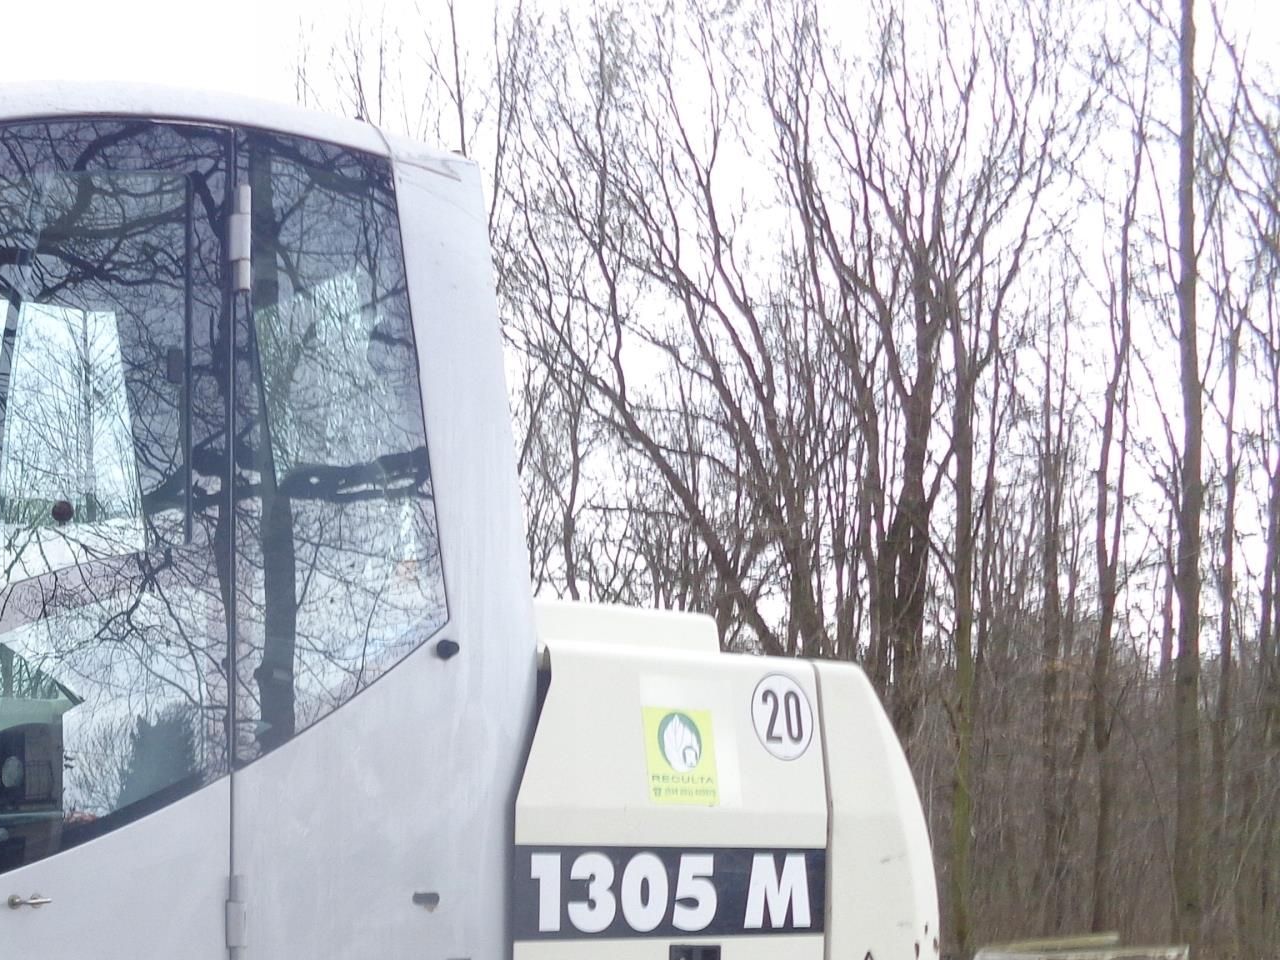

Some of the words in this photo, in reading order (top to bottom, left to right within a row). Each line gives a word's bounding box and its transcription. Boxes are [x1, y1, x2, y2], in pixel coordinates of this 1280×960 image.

[762, 689, 804, 744] 20
[530, 852, 718, 933] 1305
[744, 853, 811, 929] M
